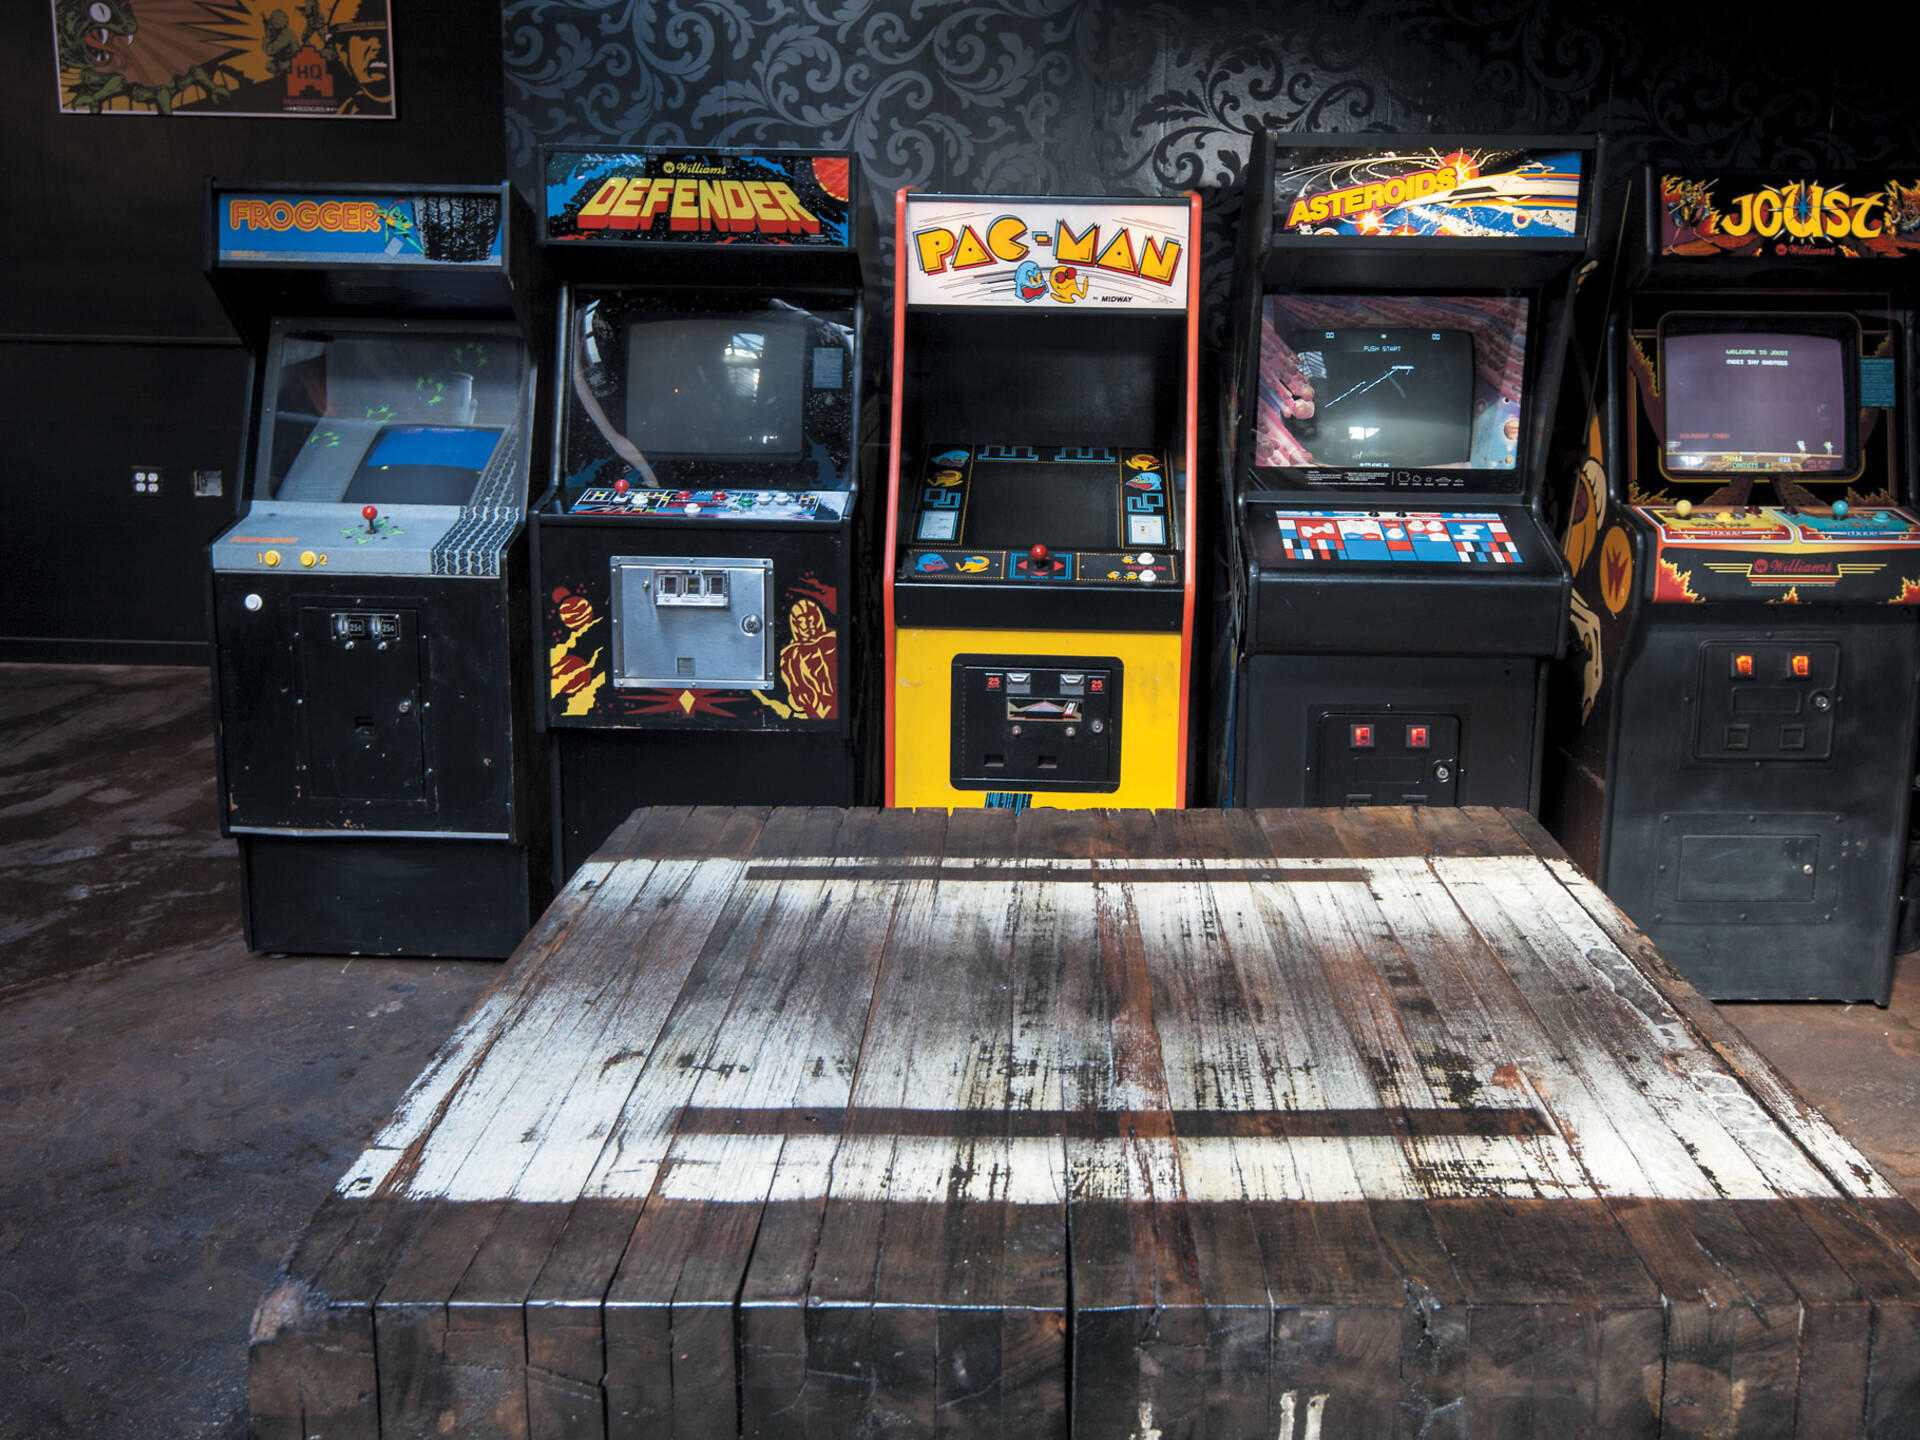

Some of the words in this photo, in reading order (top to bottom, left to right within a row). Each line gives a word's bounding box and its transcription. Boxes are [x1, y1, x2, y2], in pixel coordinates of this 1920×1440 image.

[297, 65, 322, 79] HQ
[676, 161, 727, 175] Williams
[1284, 165, 1459, 230] ASTEROIDS
[577, 177, 820, 234] DEFENDER
[230, 199, 381, 232] FROGGER
[912, 214, 1184, 287] PAC-MAN
[1101, 295, 1133, 303] MIDWAY
[256, 553, 263, 564] 1
[319, 554, 328, 565] 2
[1769, 558, 1833, 573] Williams
